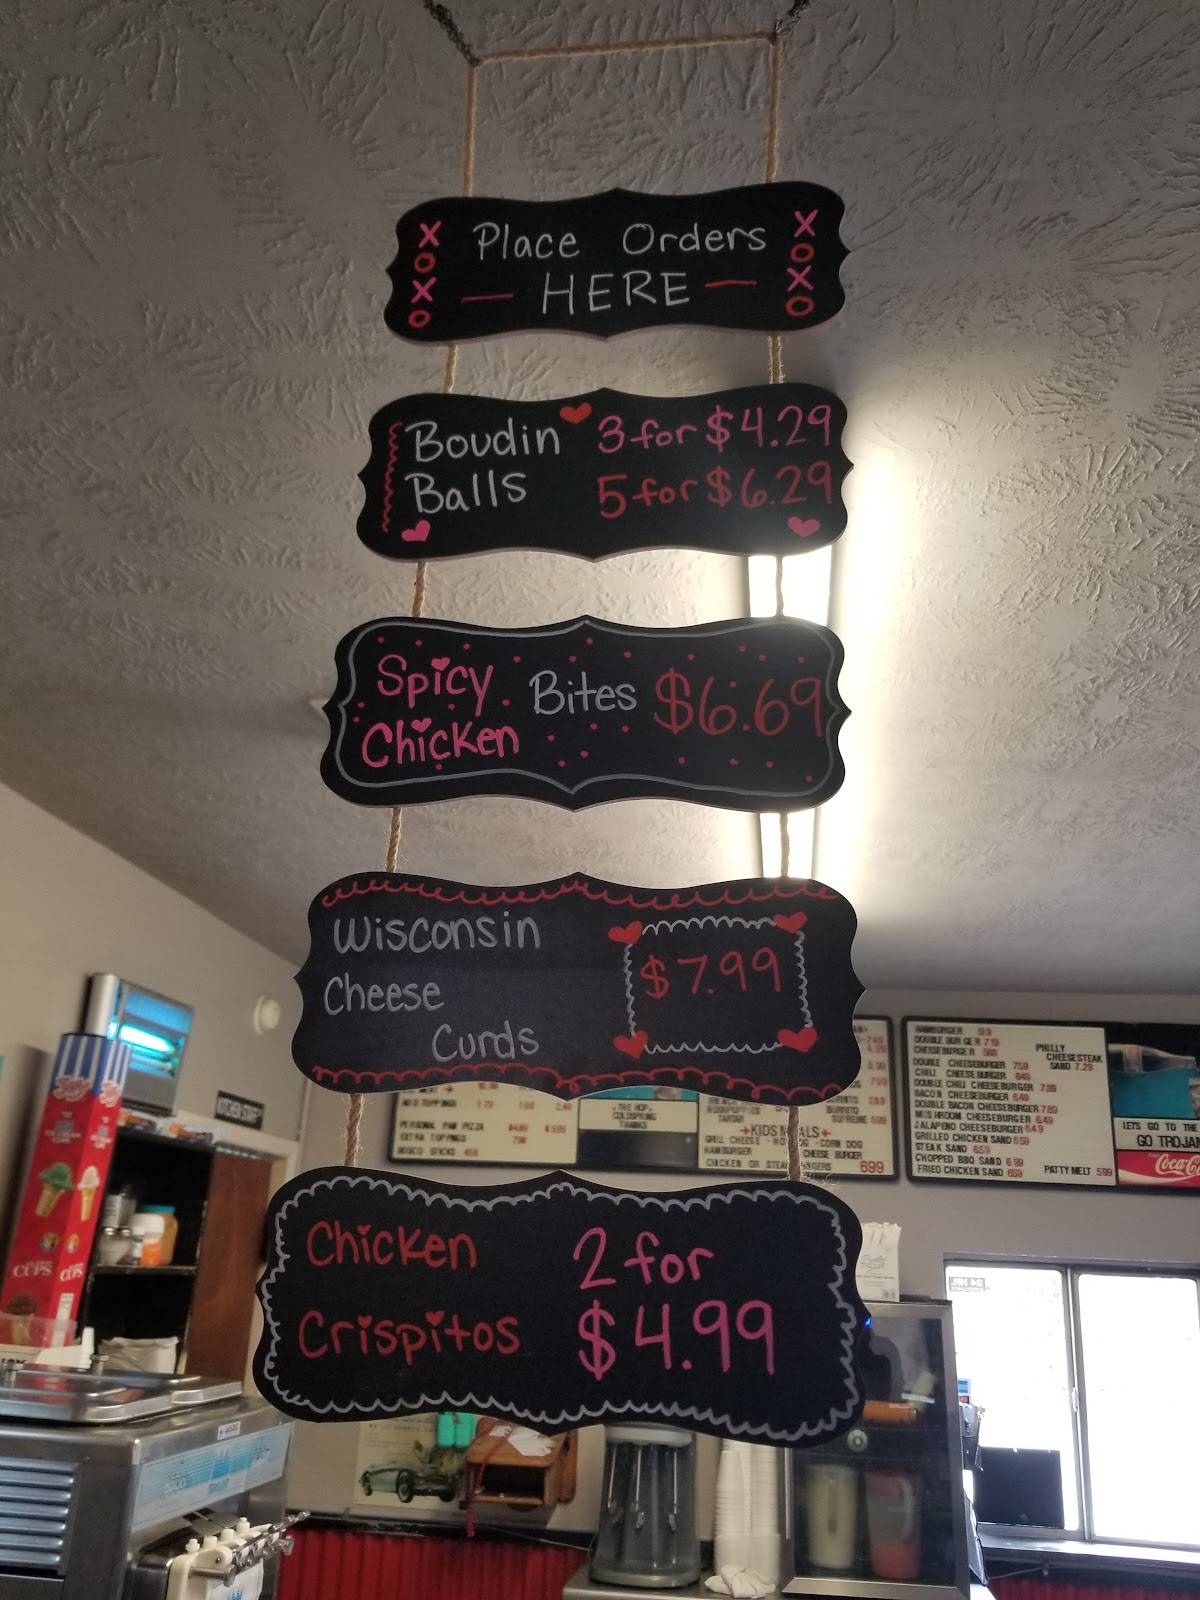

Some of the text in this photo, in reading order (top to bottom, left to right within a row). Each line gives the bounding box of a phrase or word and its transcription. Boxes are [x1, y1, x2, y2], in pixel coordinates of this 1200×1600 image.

[472, 222, 767, 261] Place Orders
[541, 271, 691, 315] HERE
[404, 417, 561, 463] Boudin
[598, 403, 833, 454] 3 for $4.29
[405, 470, 527, 515] Balls
[597, 460, 833, 519] 5 for $6.29
[377, 653, 494, 717] Spicy
[529, 669, 638, 715] Bites
[653, 667, 824, 739] $6.69
[361, 717, 520, 768] Chicken
[333, 911, 541, 954] Wisconsin
[639, 947, 783, 1000] $7.99
[323, 975, 445, 1016] Cheese
[431, 1020, 540, 1063] Curds
[1035, 1043, 1065, 1052] PHILLY
[913, 1057, 940, 1067] DOUBLE
[948, 1059, 1006, 1070] CHEESEBURGER
[1049, 1061, 1072, 1070] SAND
[914, 1079, 942, 1088] DOUBLE
[947, 1090, 1009, 1101] CHEESEBURGER
[914, 1100, 944, 1109] DOUBLE
[948, 1101, 975, 1110] BACON
[977, 1102, 1039, 1113] CHEESEBURGER
[966, 1112, 1031, 1123] CHEESEBURGER
[751, 1124, 777, 1137] KIDS
[914, 1131, 949, 1141] GRILLED
[952, 1133, 988, 1143] CHICKEN
[990, 1136, 1012, 1145] SAND
[959, 1122, 1024, 1134] CHEESEBURGER
[1136, 1134, 1153, 1147] GO
[1147, 1122, 1159, 1131] GO
[1165, 1123, 1177, 1131] TO
[1183, 1123, 1199, 1132] THE
[915, 1142, 942, 1152] STEAK
[945, 1144, 968, 1153] SAND
[915, 1153, 954, 1164] CHOPPED
[978, 1156, 1002, 1166] SAND
[860, 1161, 885, 1174] 699
[917, 1164, 940, 1174] FRIED
[943, 1166, 980, 1176] CHICKEN
[981, 1167, 1004, 1177] SAND
[1044, 1165, 1069, 1175] PATTY
[1071, 1167, 1091, 1176] MELT
[306, 1220, 478, 1270] Chicken
[572, 1226, 714, 1290] 2 for
[299, 1310, 520, 1366] Crispitos
[577, 1300, 775, 1381] $4.99
